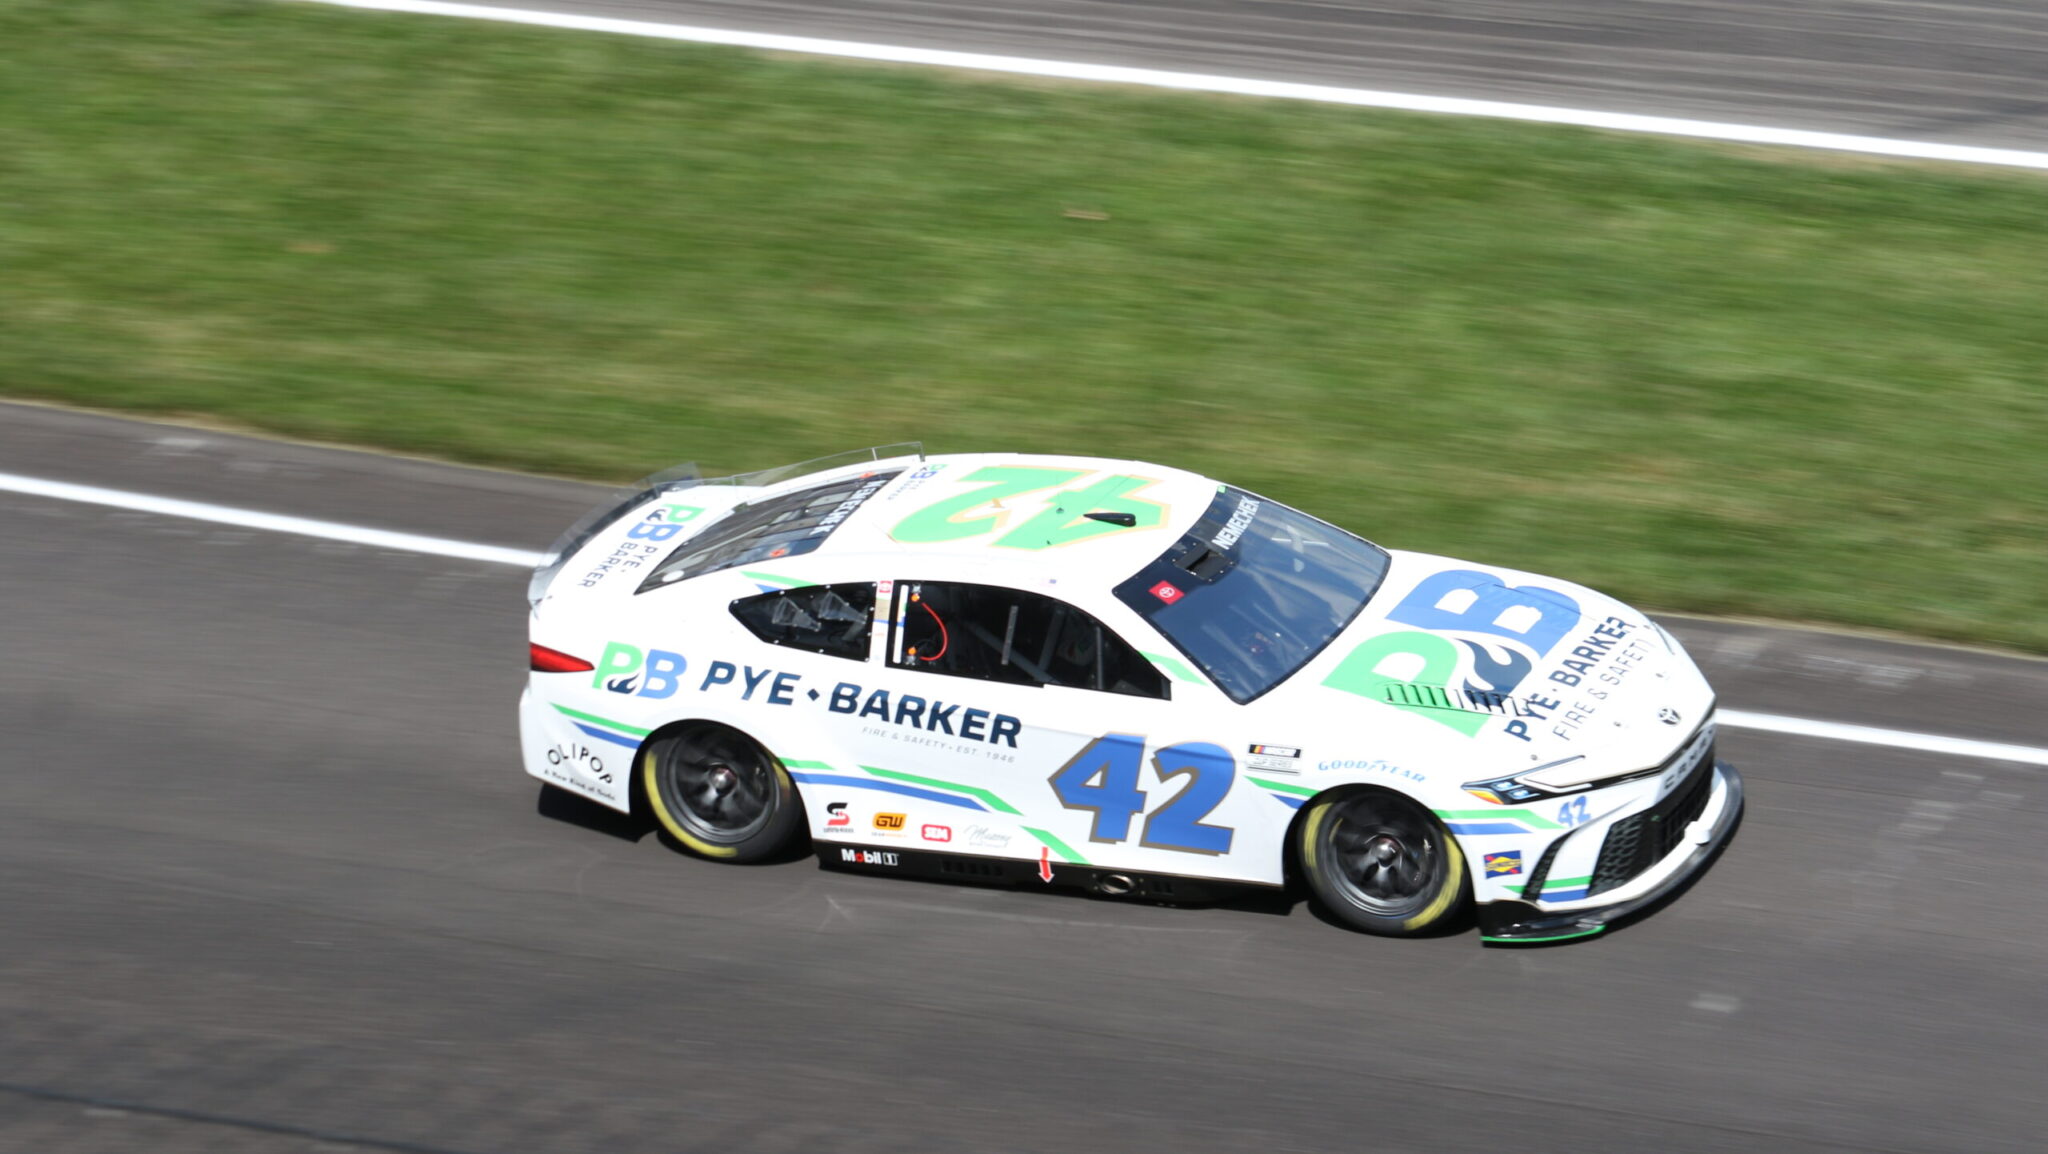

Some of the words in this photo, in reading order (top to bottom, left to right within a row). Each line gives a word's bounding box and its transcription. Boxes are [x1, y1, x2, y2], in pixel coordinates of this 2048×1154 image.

[887, 464, 1172, 551] 42
[1211, 495, 1260, 550] NEMECHEK
[577, 542, 639, 588] BARKER
[622, 545, 659, 568] PYE
[592, 641, 688, 700] PB
[699, 660, 802, 706] PYE
[828, 682, 1022, 748] BARKER
[1503, 693, 1561, 742] PYE
[1552, 701, 1596, 741] FIRE
[1587, 688, 1609, 700] &
[862, 726, 887, 738] FIRE
[903, 734, 946, 749] SAFETY
[547, 743, 613, 784] OLIPOP
[1318, 760, 1426, 782] GOODYEAR
[1047, 731, 1236, 856] 42
[1558, 795, 1591, 828] 42
[841, 848, 882, 865] Mobil
